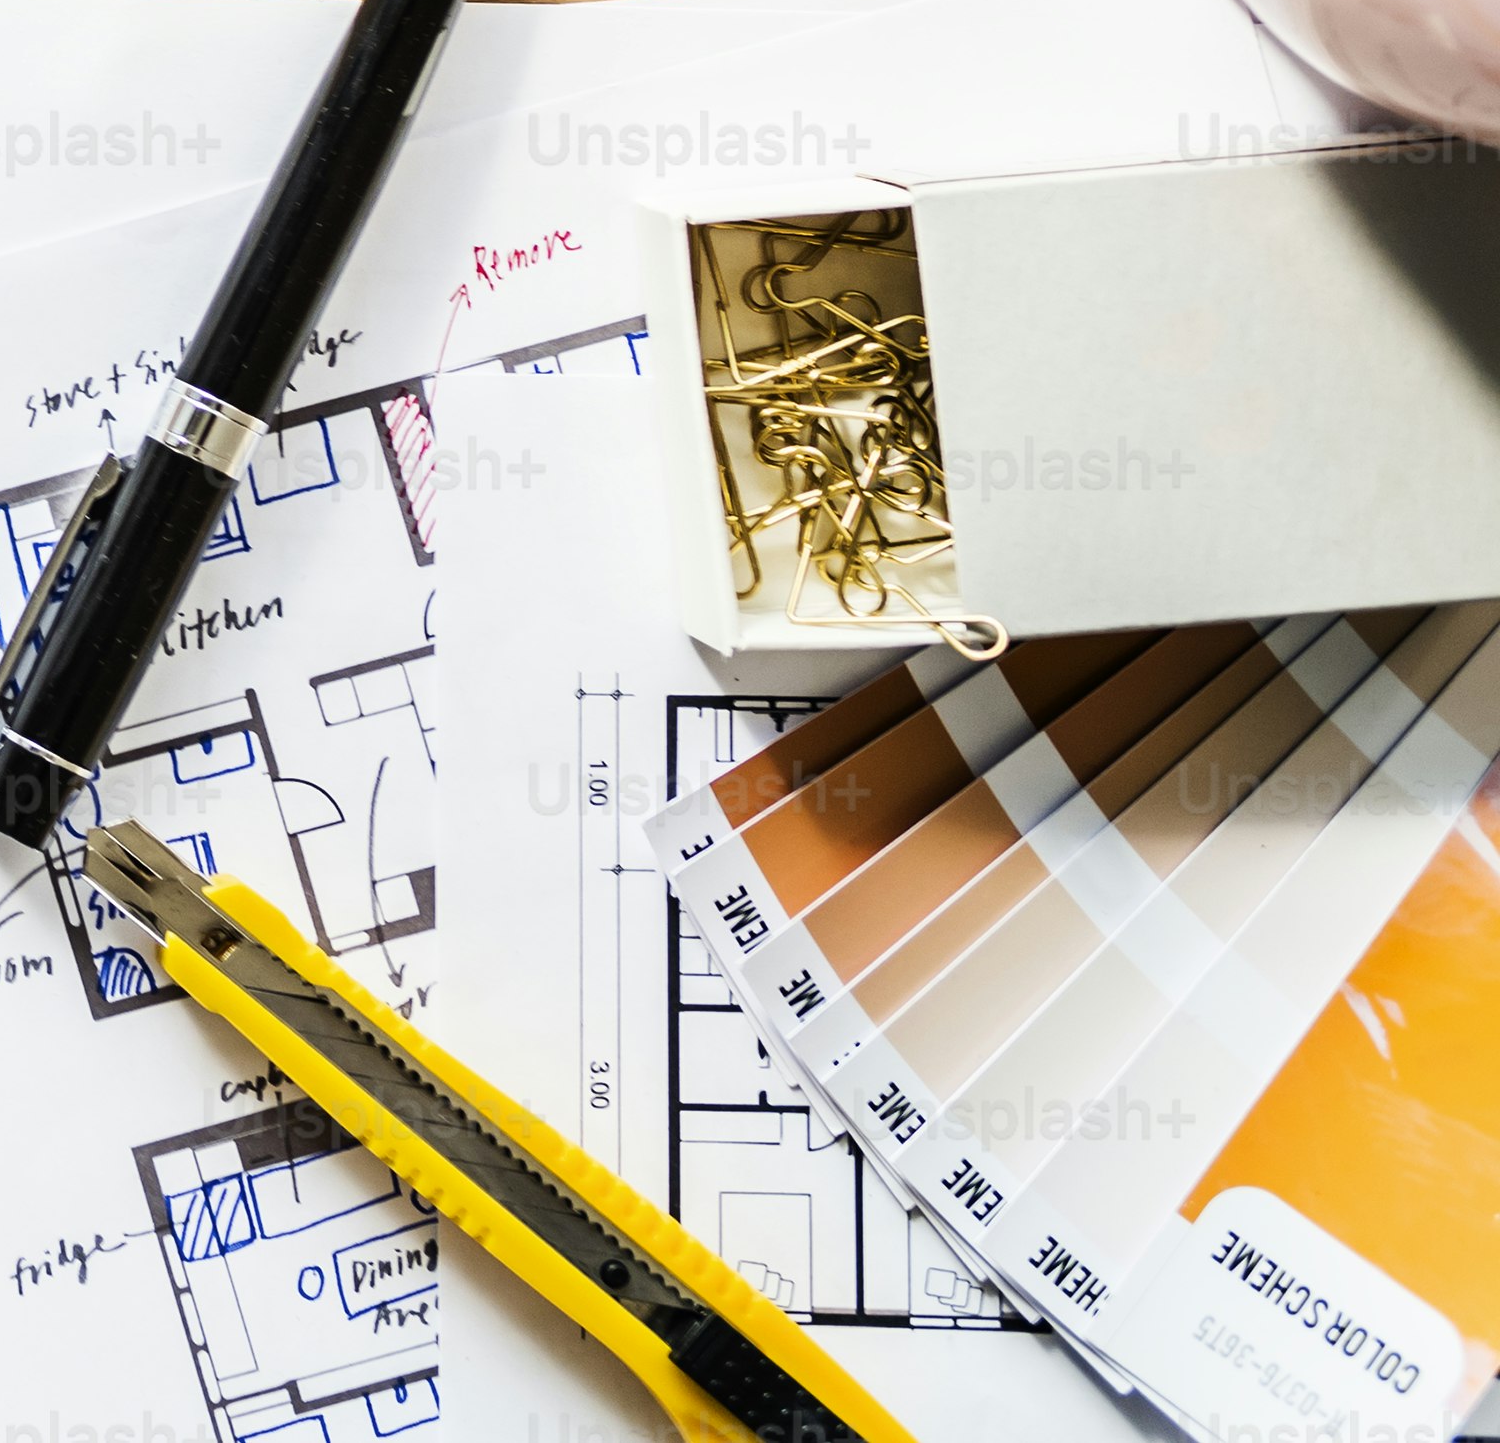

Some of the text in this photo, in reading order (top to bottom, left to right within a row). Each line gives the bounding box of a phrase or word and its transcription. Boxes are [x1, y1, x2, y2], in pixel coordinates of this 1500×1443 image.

[588, 759, 609, 807] 1.00
[590, 1061, 610, 1109] 3.00
[1211, 1229, 1421, 1394] COLOR SCHEME
